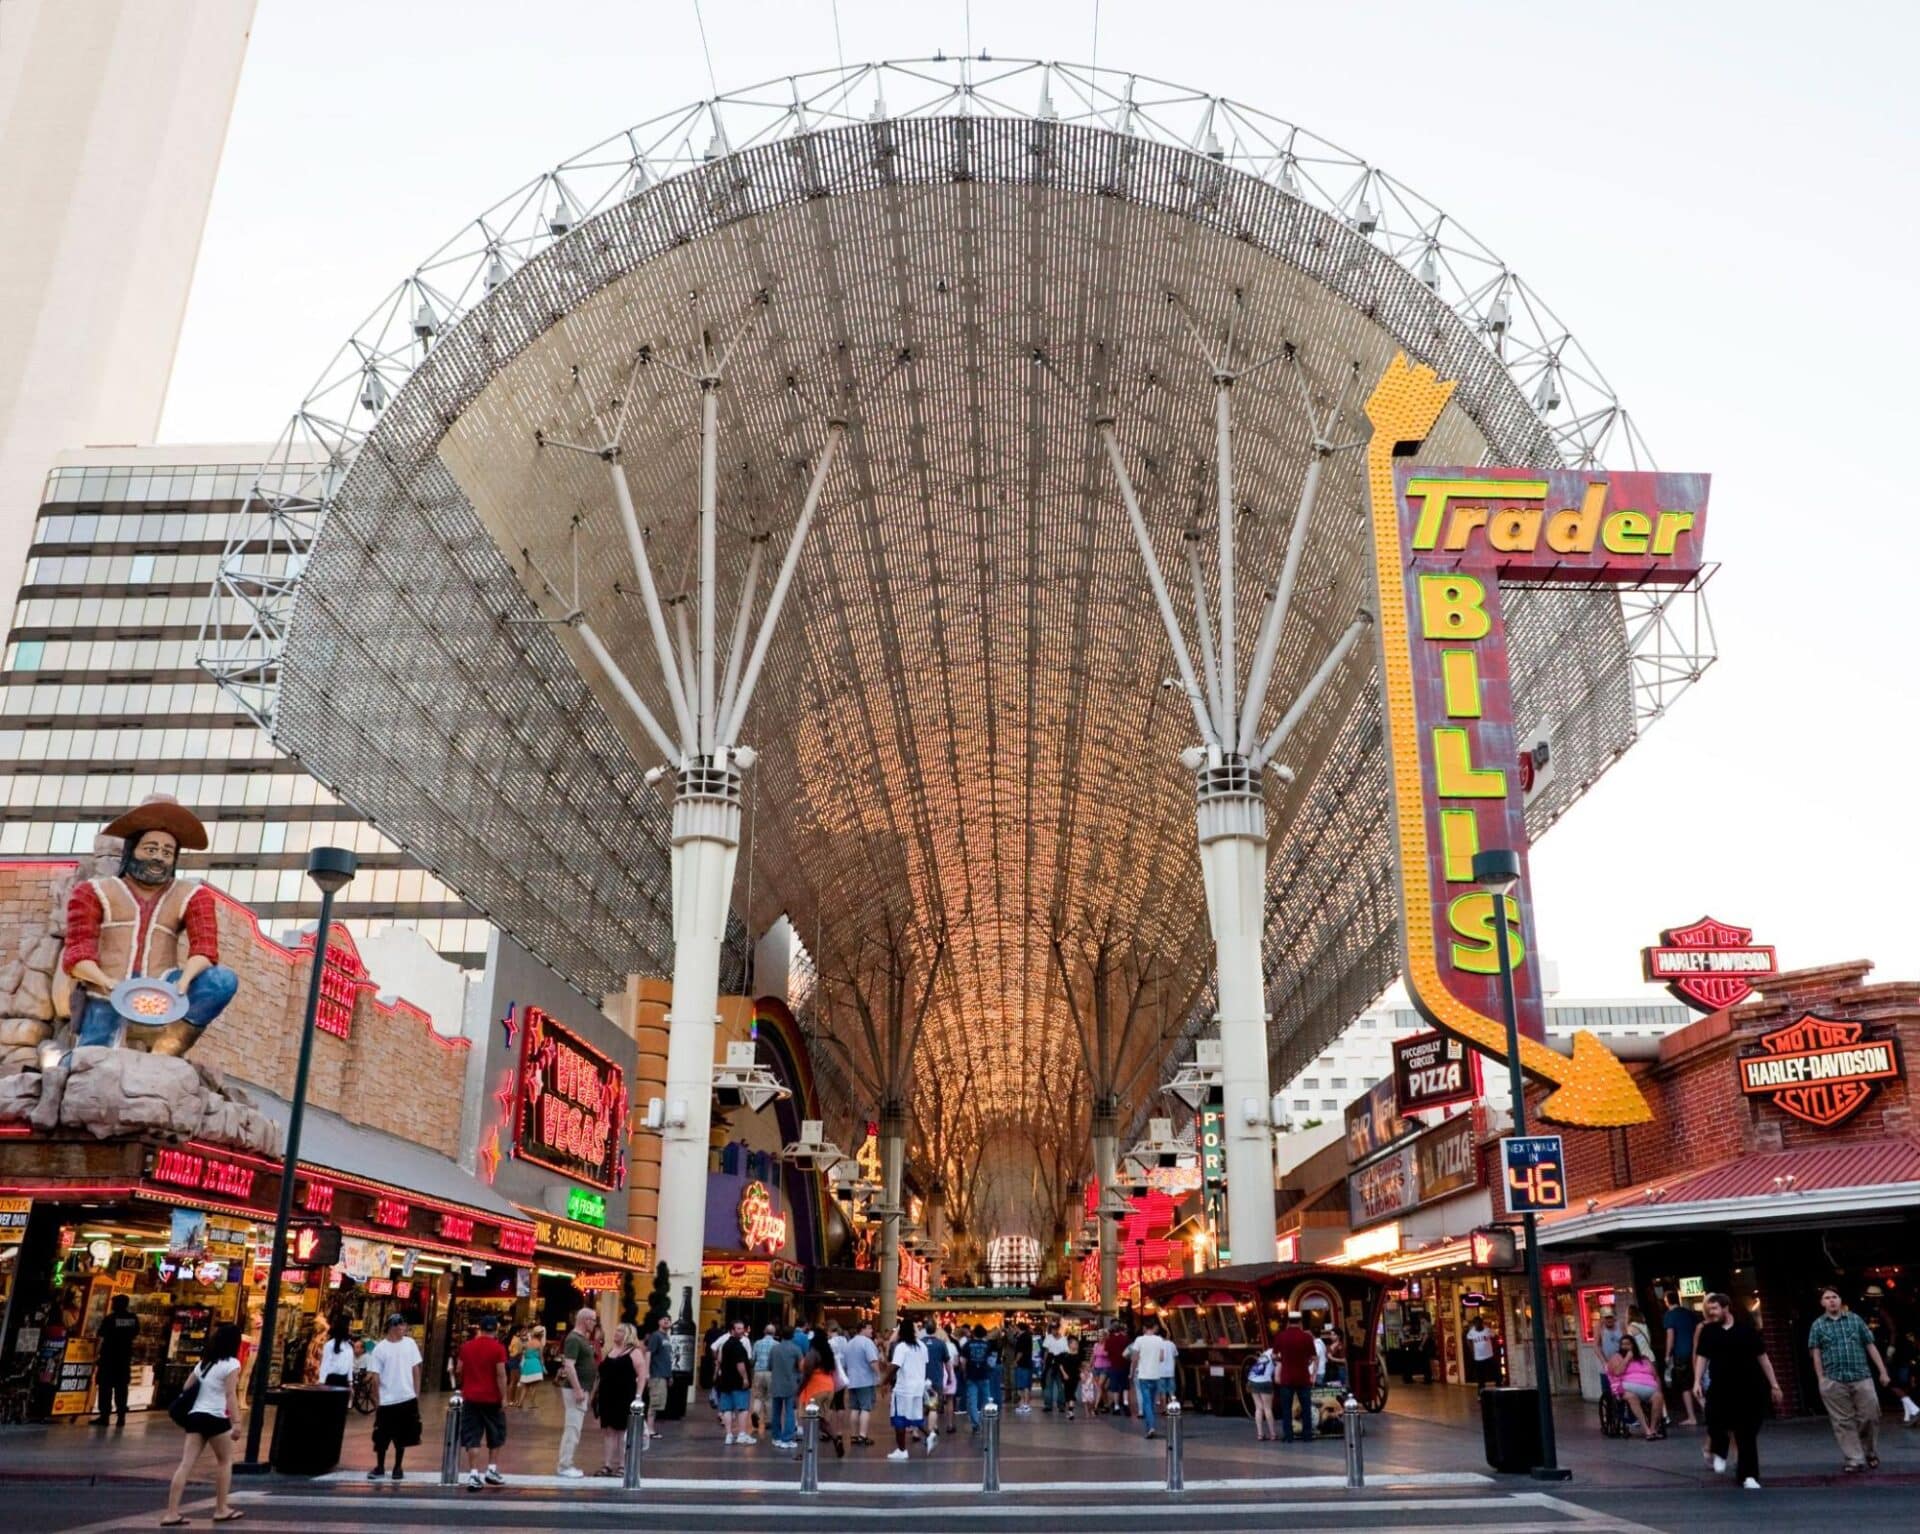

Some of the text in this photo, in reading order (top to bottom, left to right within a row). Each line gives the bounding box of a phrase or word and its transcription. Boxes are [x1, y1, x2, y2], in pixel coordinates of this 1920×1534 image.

[1405, 477, 1694, 555] Trader
[1683, 926, 1743, 945] MOTOR
[1658, 952, 1770, 971] HARLEY-DAVIDSON
[1401, 1040, 1441, 1060] PICCADILLY
[1776, 1022, 1850, 1052] MOTOR
[1409, 1054, 1435, 1069] CIRCUS
[1747, 1046, 1889, 1087] HARLEY-DAVIDSON
[1408, 1062, 1461, 1097] PIZZA
[1782, 1081, 1861, 1119] CYCLES
[543, 1093, 609, 1166] VEGAS
[1436, 1130, 1472, 1179] PIZZA
[1509, 1142, 1558, 1153] NEXT WALK
[1528, 1152, 1539, 1161] IN
[1509, 1163, 1562, 1204] 46
[557, 1226, 593, 1253] SOUVENIRS
[597, 1236, 624, 1260] CLOTHING
[627, 1245, 646, 1265] LIQUOR
[579, 1278, 614, 1287] LIQUOR
[1686, 1279, 1704, 1294] ATM
